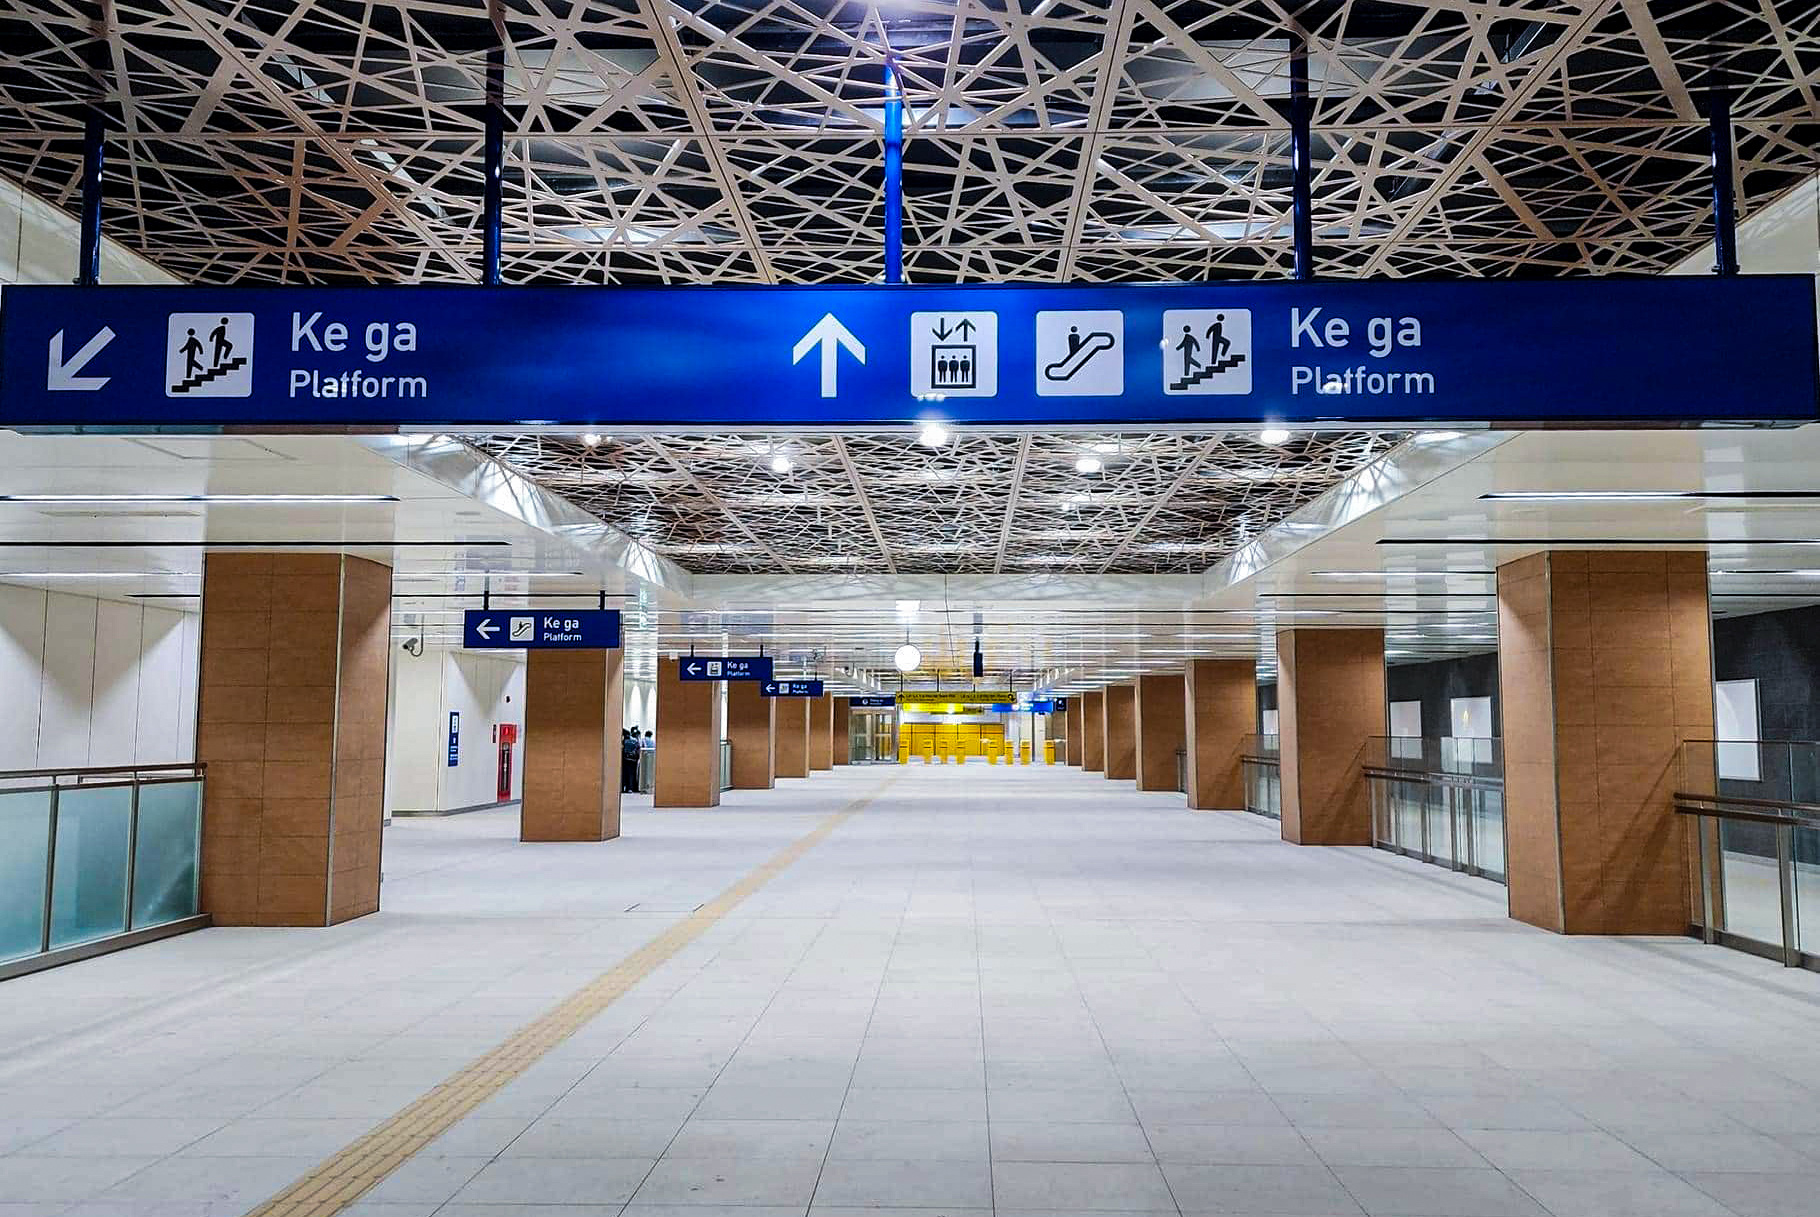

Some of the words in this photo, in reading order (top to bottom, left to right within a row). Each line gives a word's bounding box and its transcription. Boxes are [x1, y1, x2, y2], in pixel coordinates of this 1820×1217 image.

[291, 311, 349, 352] Ke
[365, 322, 417, 363] ga
[1291, 306, 1350, 348] Ke
[1367, 316, 1422, 358] ga
[289, 369, 428, 399] Platform
[1291, 365, 1436, 395] Platform
[543, 616, 561, 629] Ke
[564, 619, 580, 632] ga
[543, 632, 582, 642] Platform
